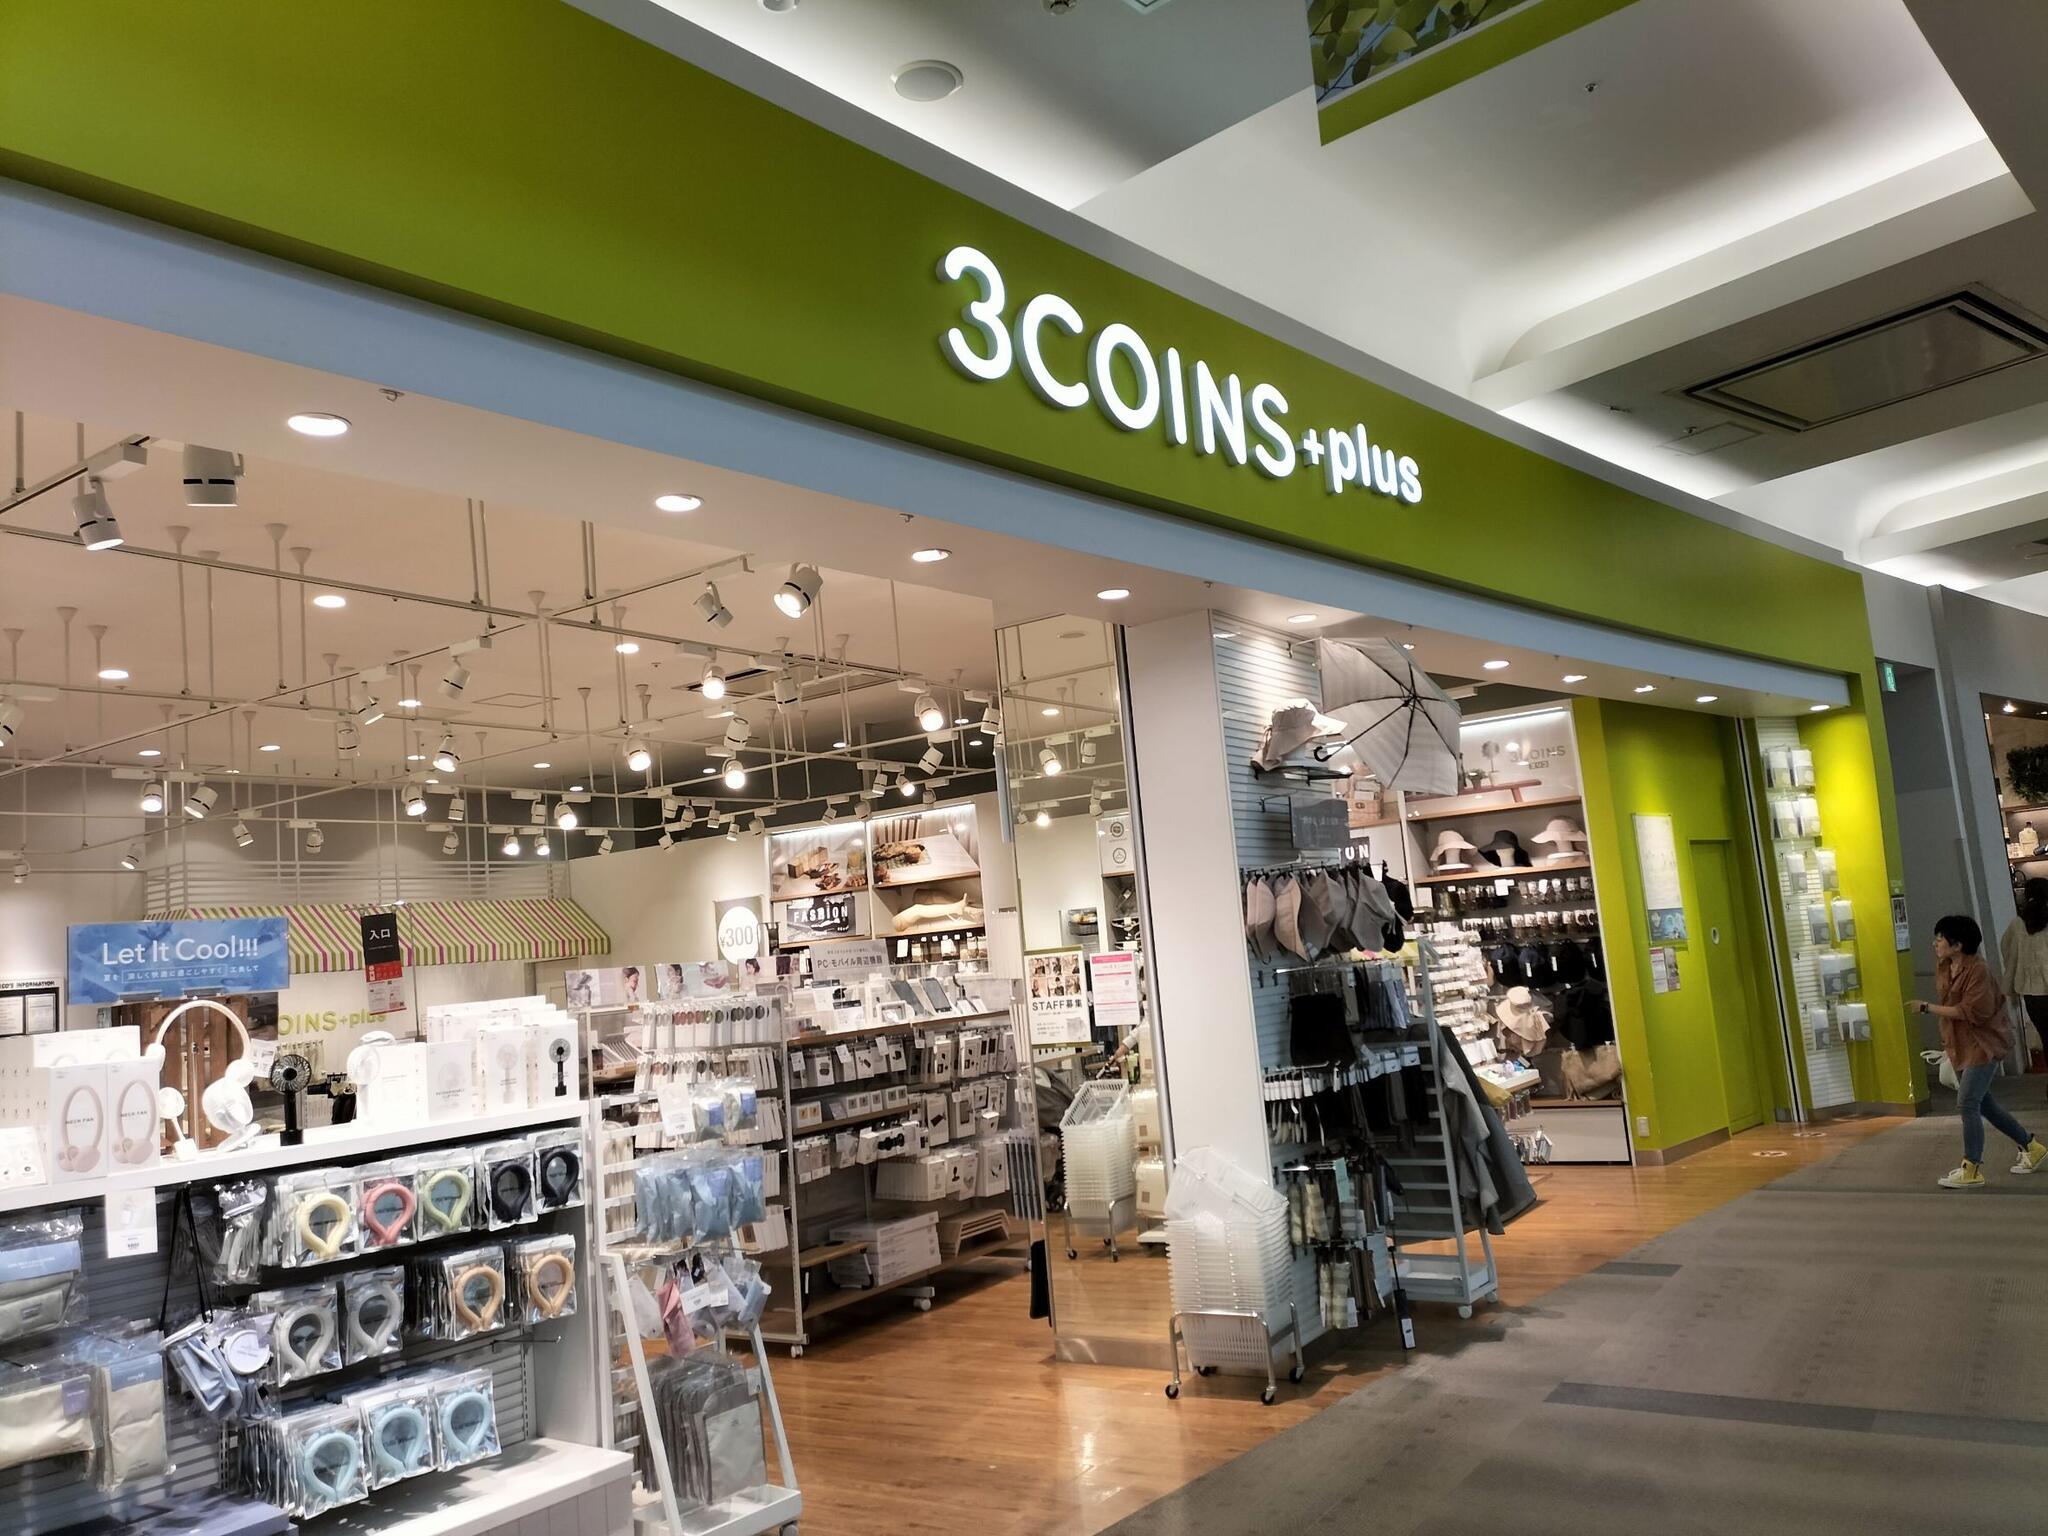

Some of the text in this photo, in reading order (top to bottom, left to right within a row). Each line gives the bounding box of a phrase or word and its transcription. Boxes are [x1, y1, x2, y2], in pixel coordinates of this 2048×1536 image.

[369, 928, 391, 940] 入口
[720, 926, 753, 949] ¥300
[103, 935, 259, 965] Let It Cool!!!
